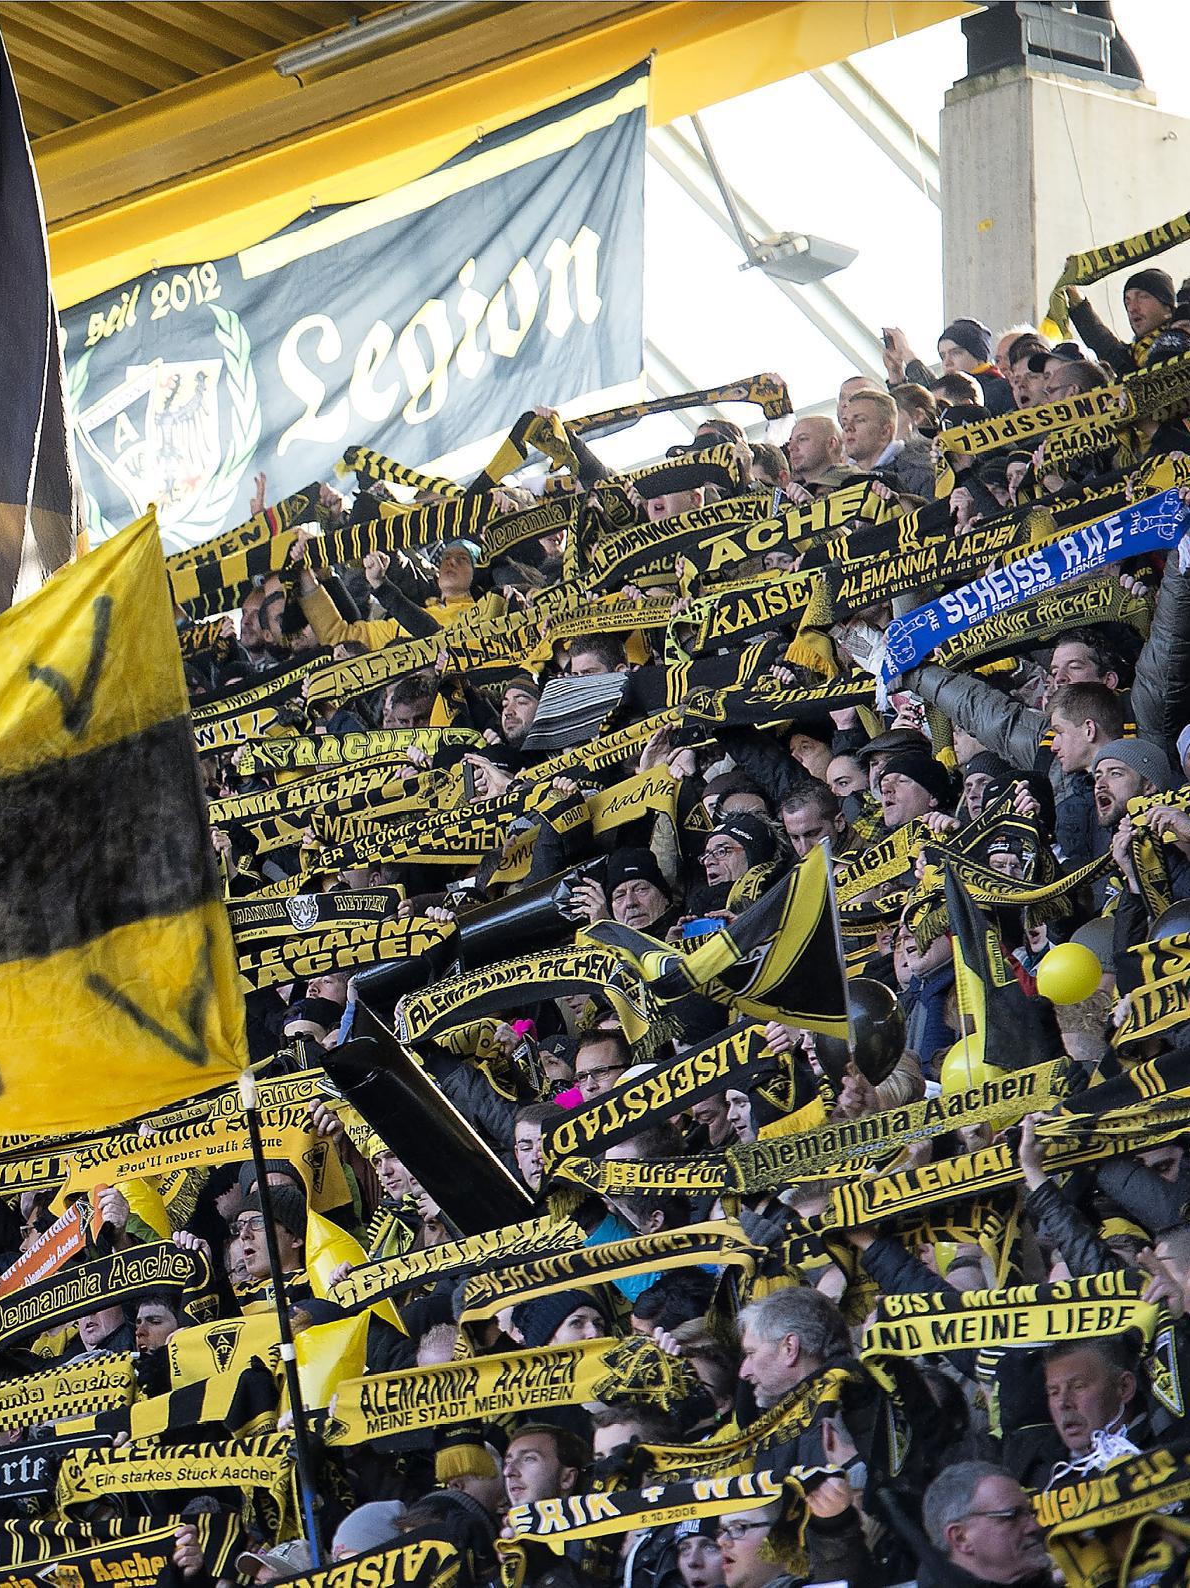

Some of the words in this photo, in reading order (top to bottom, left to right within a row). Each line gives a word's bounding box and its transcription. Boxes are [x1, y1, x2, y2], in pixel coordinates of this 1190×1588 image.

[150, 260, 224, 321] 2012
[277, 222, 606, 459] Legion
[688, 498, 771, 530] AACHEN
[835, 547, 938, 604] ALEMANNIA
[943, 522, 1022, 564] AACHEN
[938, 550, 1052, 625] SCHEISS
[968, 610, 988, 626] GIB
[1024, 576, 1057, 599] KEINE
[1060, 553, 1108, 582] CHANCE
[1036, 586, 1114, 623] AACHEN
[266, 678, 286, 696] TSV
[294, 728, 443, 768] AACHEN
[561, 805, 585, 829] 1900
[752, 1107, 911, 1174] Alemannia
[922, 1071, 1037, 1126] Aachen
[116, 1155, 162, 1177] You'll
[164, 1149, 202, 1164] never
[206, 1138, 239, 1157] walk
[884, 1291, 946, 1317] BIST
[961, 1283, 1039, 1310] MEIN
[931, 1310, 1031, 1346] MEINE
[1046, 1304, 1137, 1336] LIEBE
[360, 1365, 480, 1420] ALEMANNIA
[492, 1349, 585, 1394] AACHEN
[366, 1411, 416, 1435] MEINE
[418, 1401, 472, 1424] STADT,
[474, 1393, 514, 1414] MEIN
[515, 1383, 577, 1407] VEREIN
[83, 1435, 293, 1470] ALEMANNIA
[95, 1473, 116, 1488] Ein
[121, 1468, 173, 1483] starkes
[179, 1466, 218, 1482] Stück
[509, 1489, 622, 1535] ERIK
